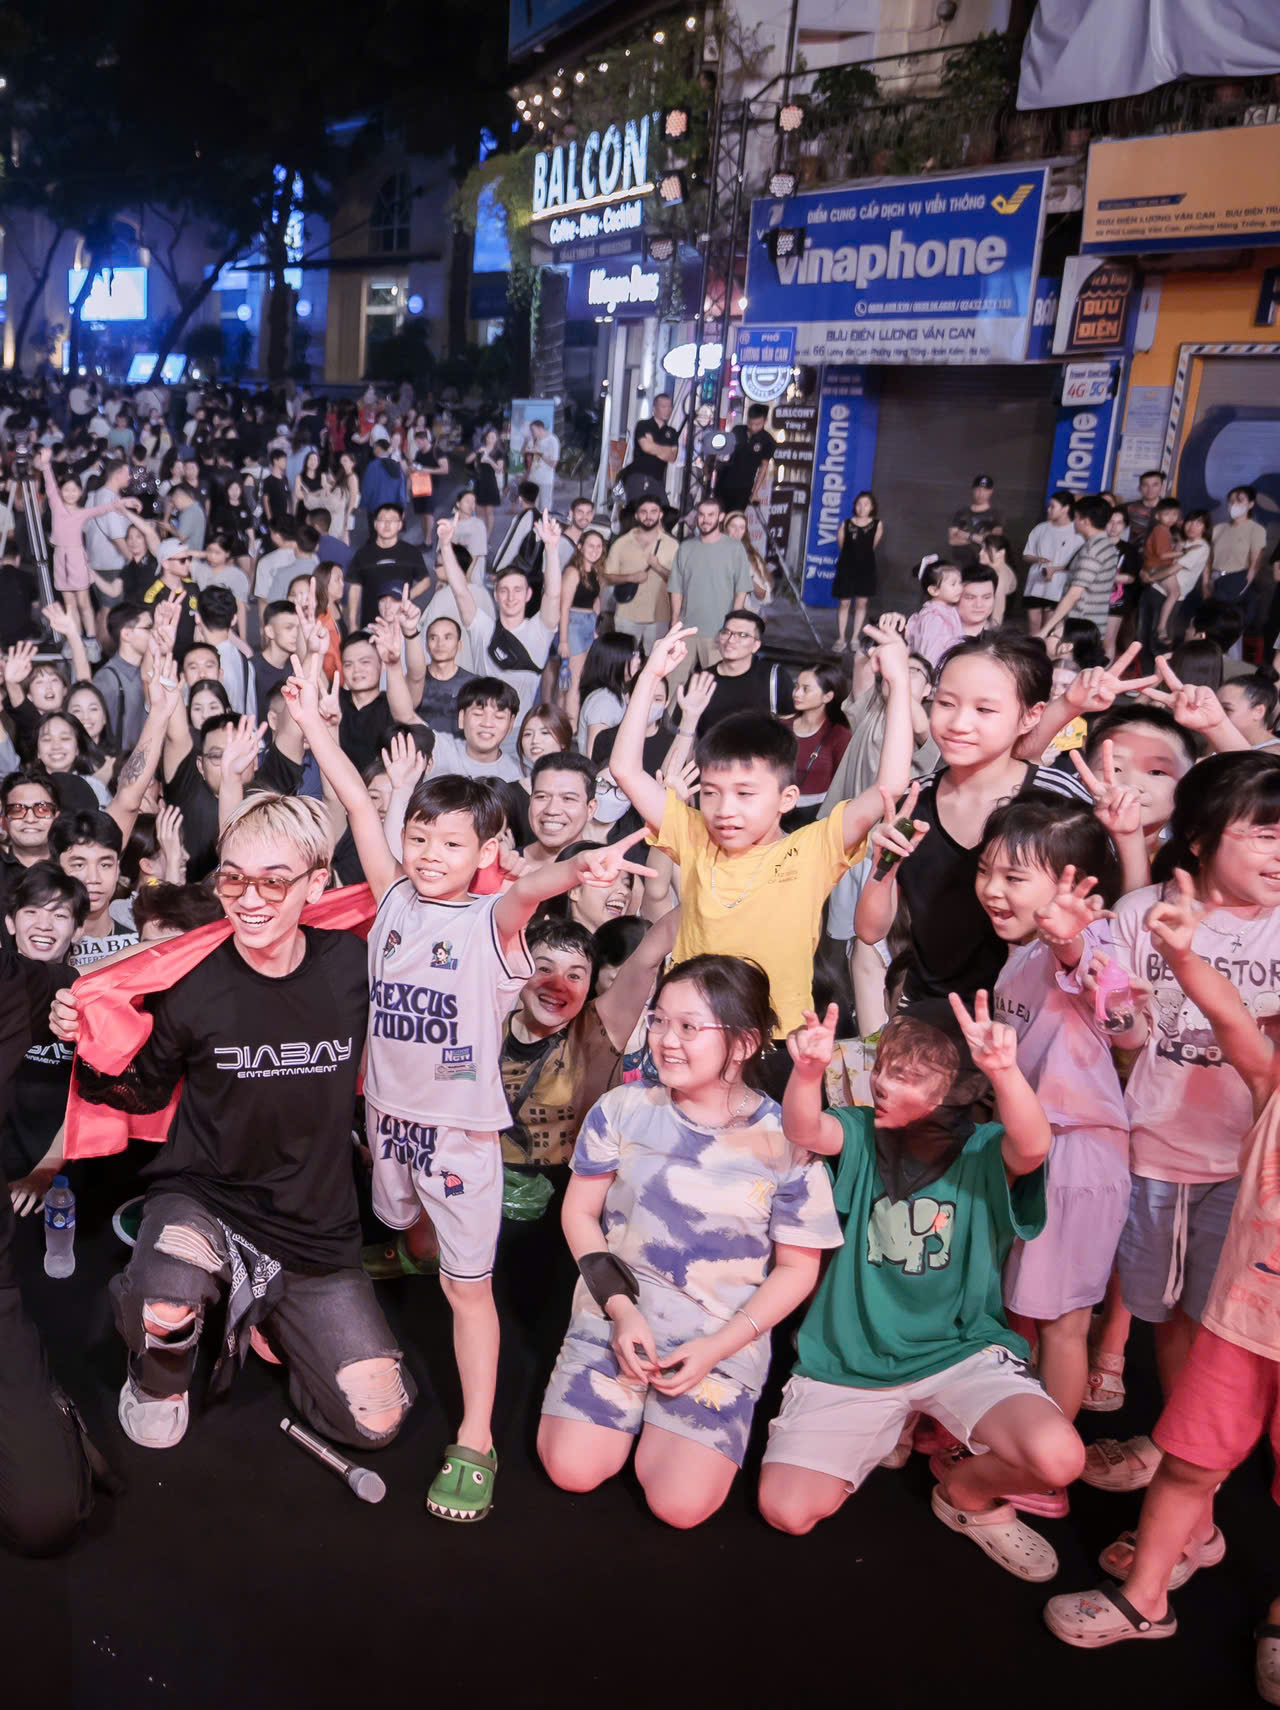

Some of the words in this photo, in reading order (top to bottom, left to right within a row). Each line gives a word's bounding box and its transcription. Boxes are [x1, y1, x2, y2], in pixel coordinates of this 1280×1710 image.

[533, 112, 661, 212] BALCON
[776, 229, 1008, 290] vinaphone
[1067, 383, 1087, 398] 4G
[817, 403, 850, 546] vinaphone
[1056, 412, 1098, 491] hone
[372, 1009, 459, 1047] TUDIO!
[214, 1037, 353, 1070] DIABAY
[237, 1064, 338, 1079] ENTERTAINMENT
